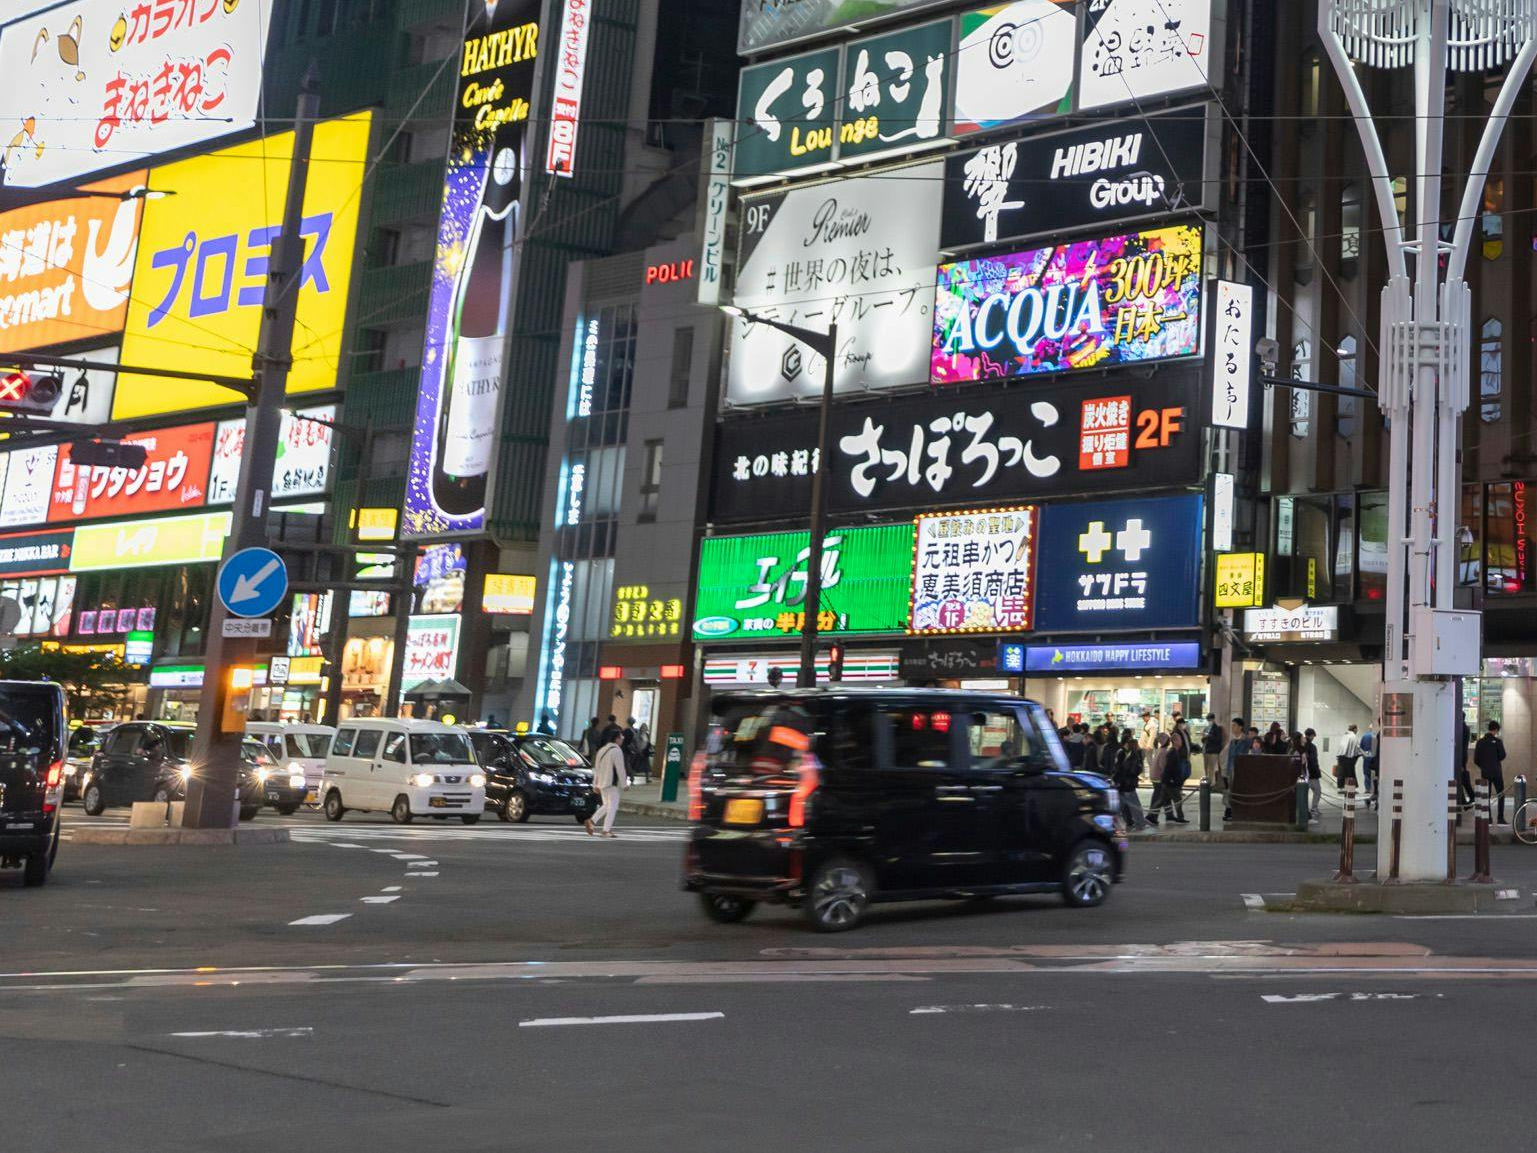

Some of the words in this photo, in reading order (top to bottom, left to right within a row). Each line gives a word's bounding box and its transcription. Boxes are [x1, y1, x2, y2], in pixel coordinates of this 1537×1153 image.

[461, 22, 539, 77] HATHYR
[95, 48, 232, 148] まねきねこ
[474, 98, 529, 131] Capella
[755, 49, 914, 143] くろねこ
[790, 116, 880, 157] Lounge
[1050, 133, 1142, 180] HIBIKI
[963, 141, 1025, 243] 響
[1090, 177, 1164, 209] Group
[704, 182, 727, 283] グリーンビル
[748, 205, 771, 234] 9F
[804, 198, 871, 247] Premier
[944, 281, 1104, 358] ACQUA
[1114, 306, 1187, 345] 日本一
[1083, 400, 1130, 429] 炭火焼き
[1135, 407, 1185, 449] 2F
[840, 401, 1060, 497] さっぽろっこ
[923, 540, 1014, 568] 元祖串かつ
[1078, 572, 1148, 596] サツドラ
[1218, 580, 1252, 596] 四文屋
[1258, 616, 1323, 630] すすきのビル
[1066, 650, 1102, 663] HOKKAIDO
[1105, 650, 1129, 662] HAPPY
[1131, 649, 1170, 661] LIFESTYLE
[669, 736, 684, 745] TAXI
